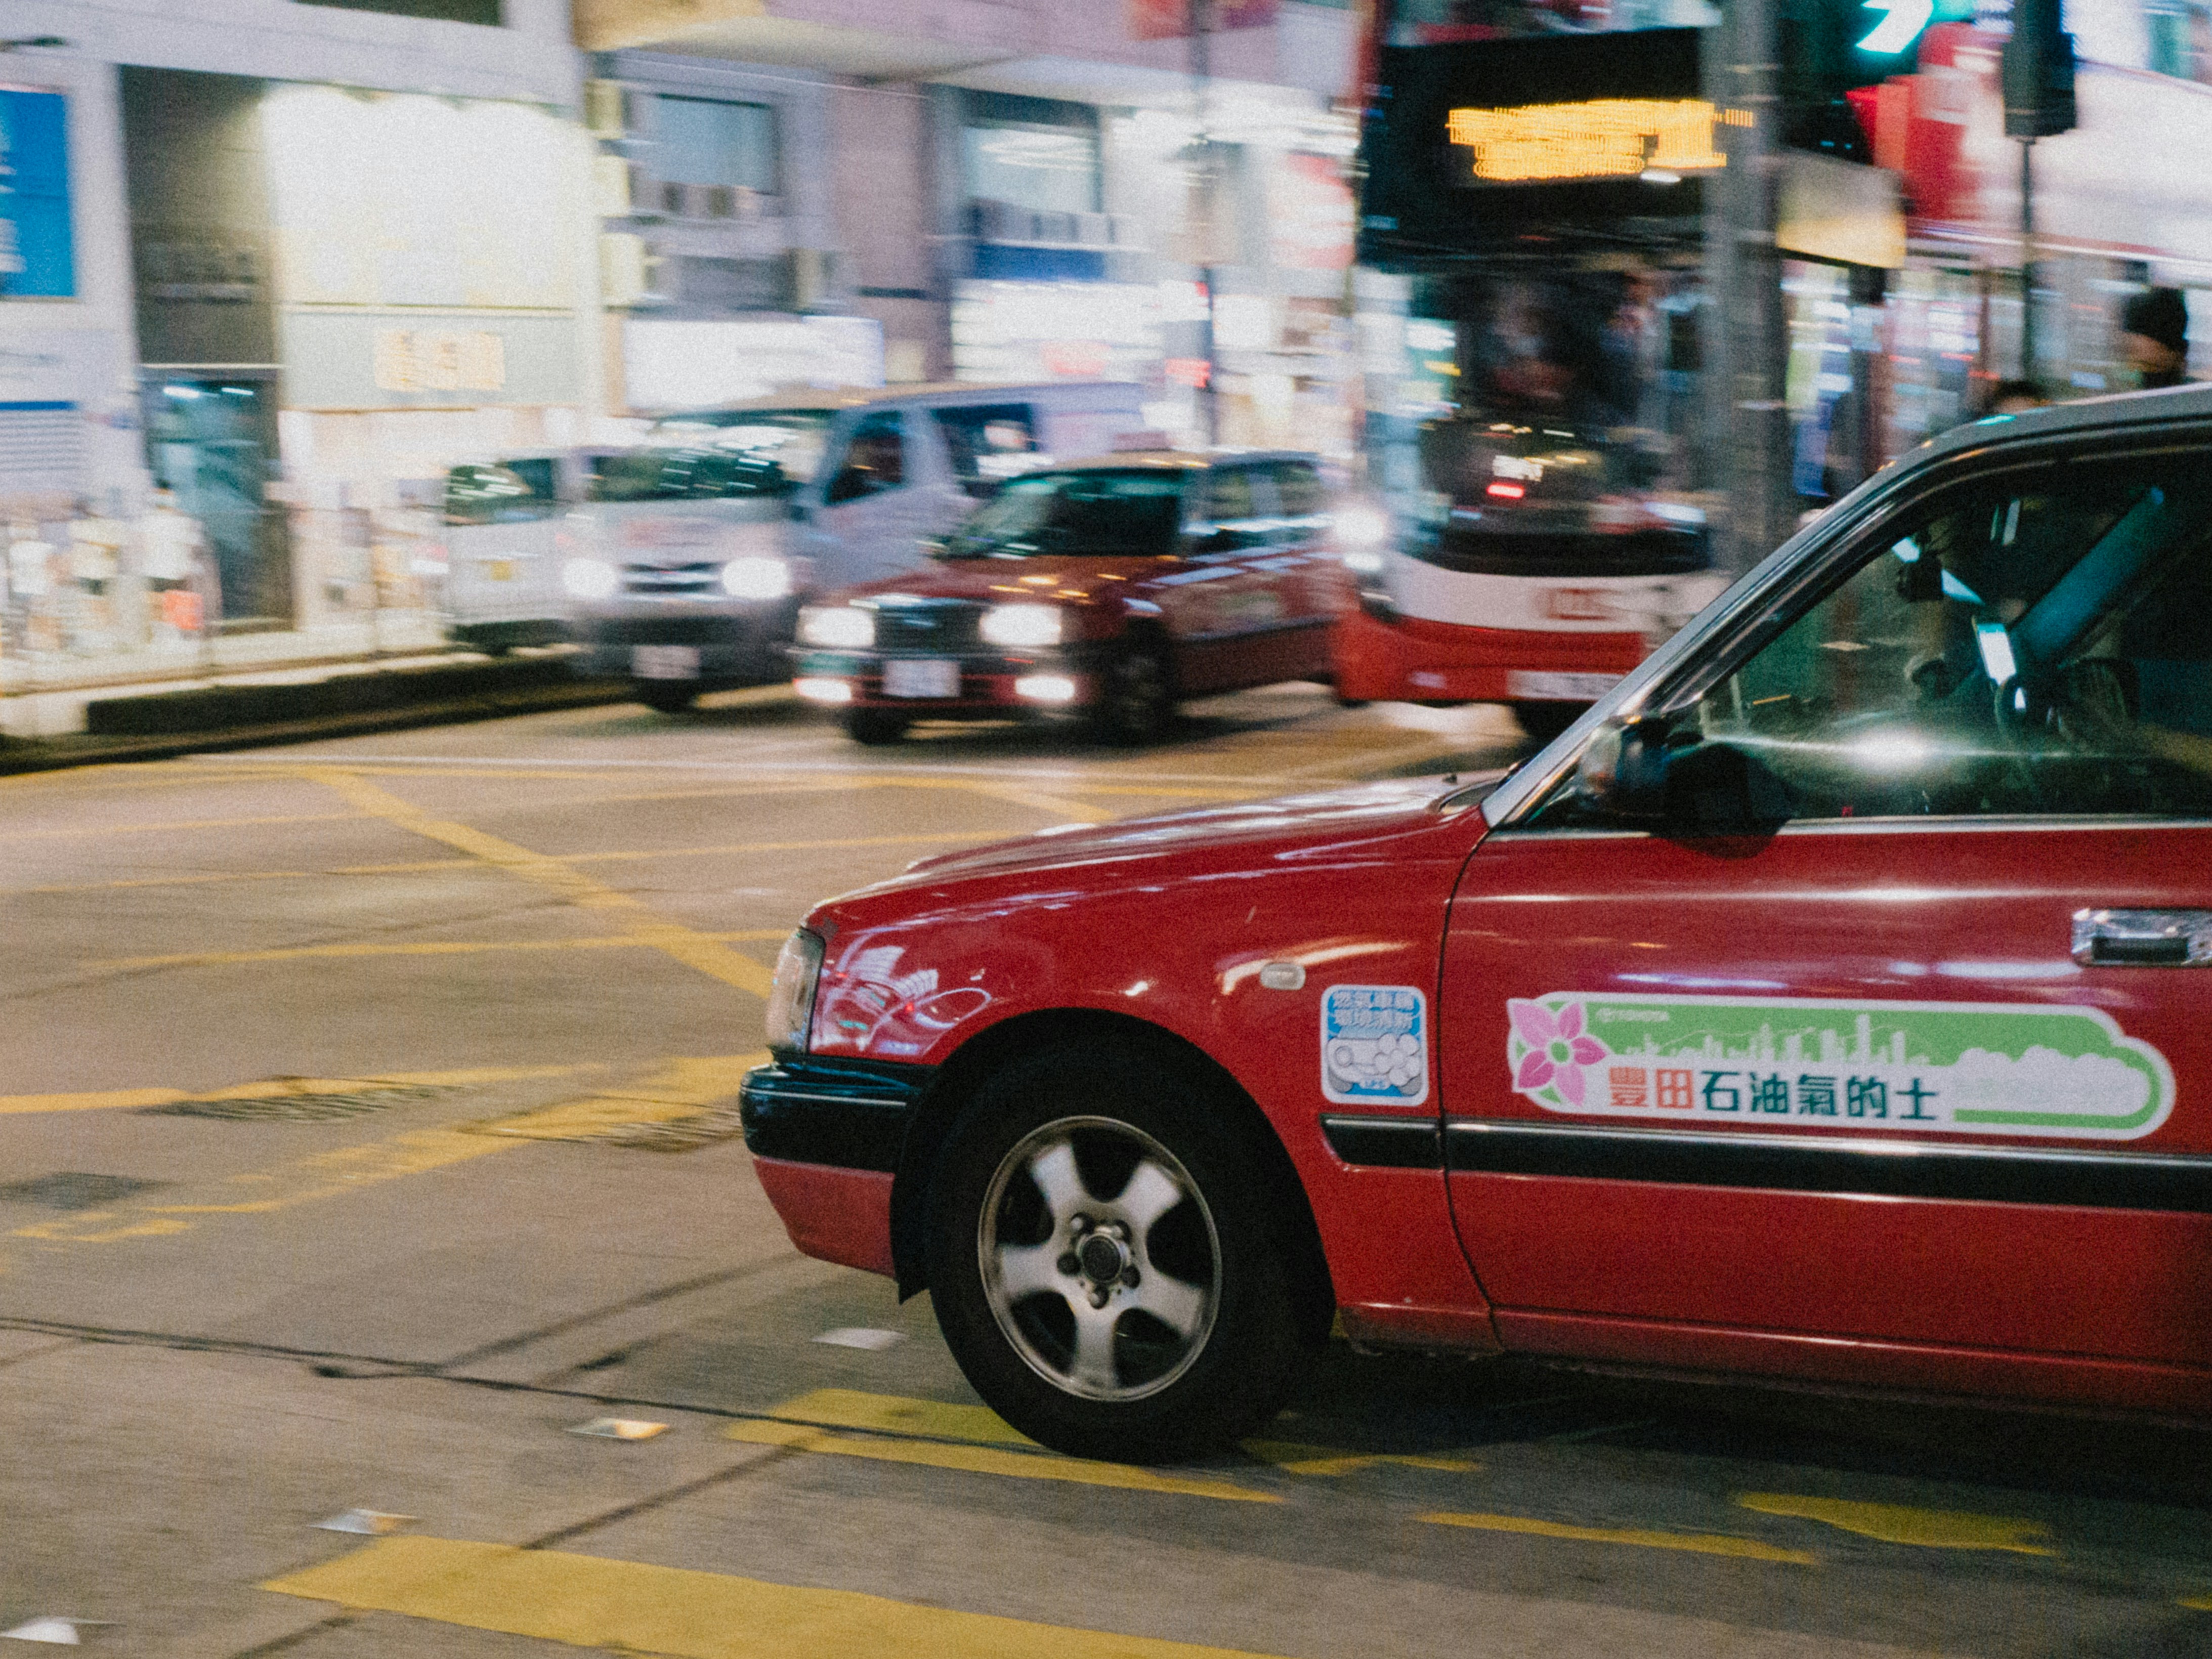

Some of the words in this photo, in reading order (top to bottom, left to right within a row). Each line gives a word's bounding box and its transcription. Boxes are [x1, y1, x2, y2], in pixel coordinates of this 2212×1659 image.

[1609, 1067, 1937, 1120] 豐田石油氣的士
